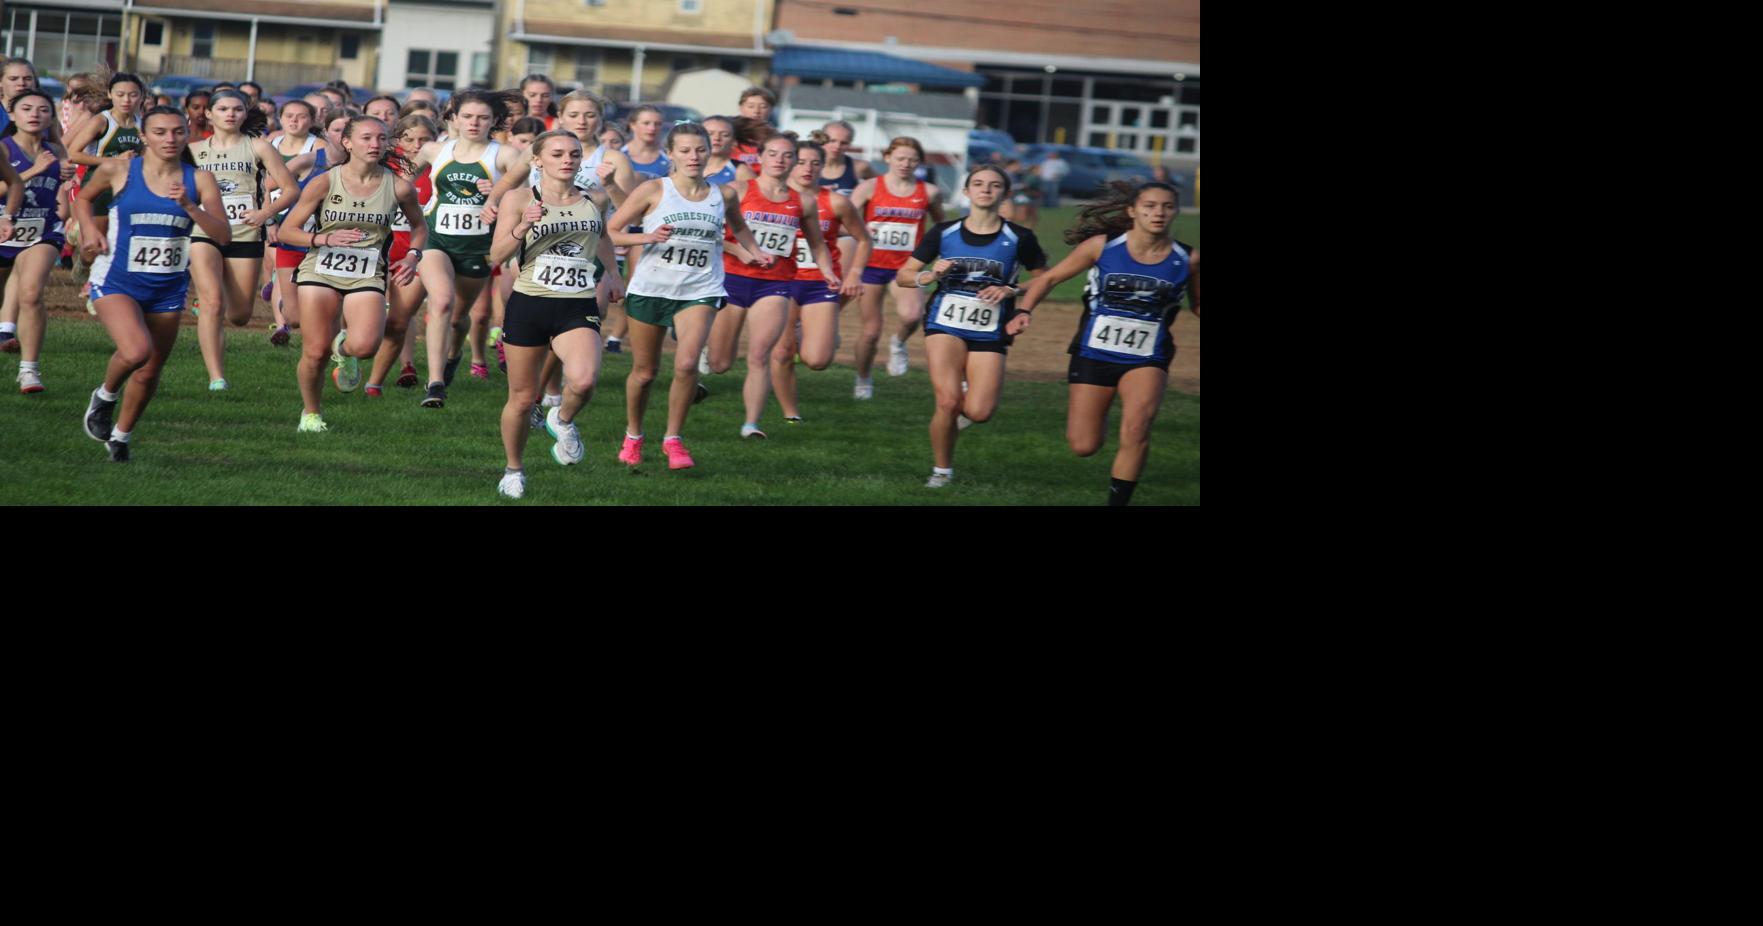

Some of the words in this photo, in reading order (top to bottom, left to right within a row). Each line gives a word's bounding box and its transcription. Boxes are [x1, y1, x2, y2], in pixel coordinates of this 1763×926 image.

[197, 161, 252, 174] OUTHERN
[446, 172, 479, 184] GREEN
[445, 191, 484, 205] DRAGONS
[226, 203, 248, 220] 32
[324, 209, 391, 227] SOUTHERN
[440, 212, 482, 230] 4181
[15, 226, 37, 242] 22
[531, 219, 602, 240] SOUTHERN
[752, 229, 789, 252] 152
[134, 247, 182, 267] 4236
[320, 251, 369, 275] 4231
[661, 246, 709, 268] 4165
[537, 265, 588, 288] 4235
[943, 303, 992, 327] 4149
[1096, 325, 1150, 350] 4147
